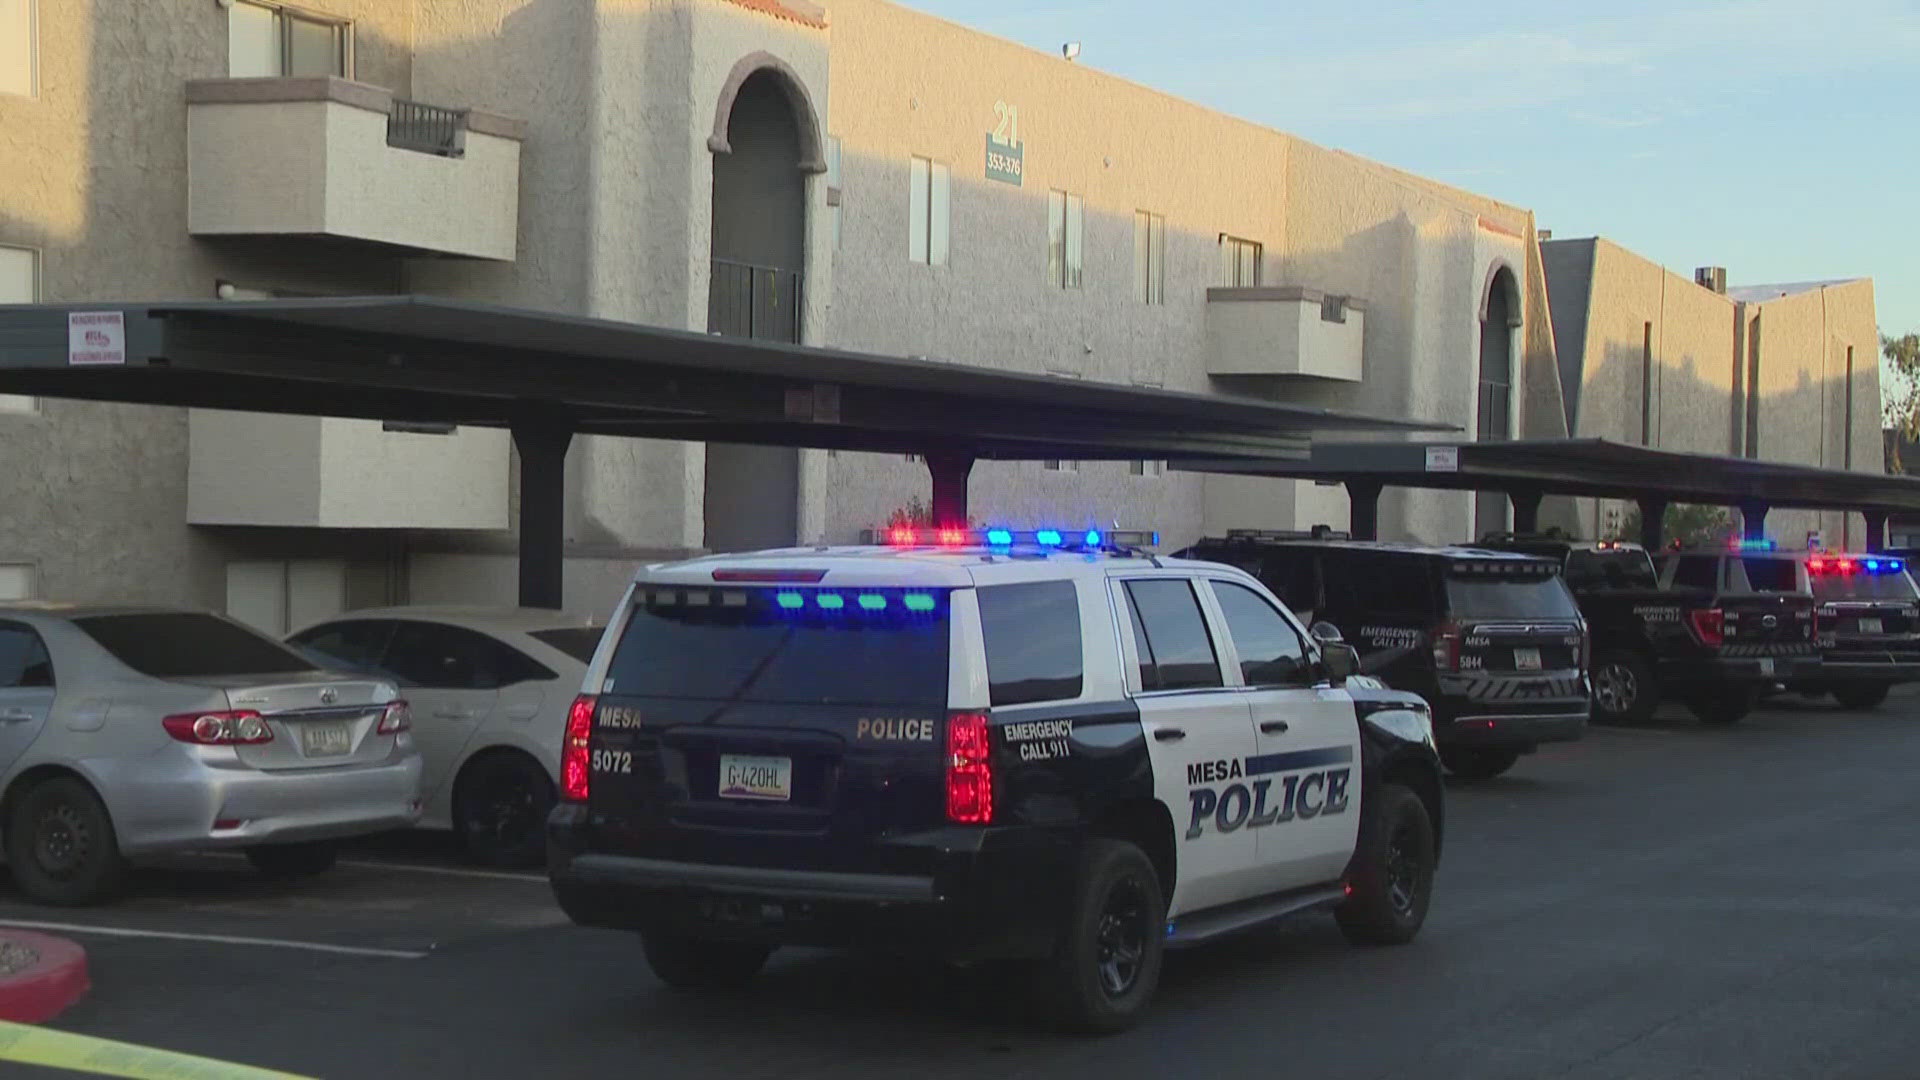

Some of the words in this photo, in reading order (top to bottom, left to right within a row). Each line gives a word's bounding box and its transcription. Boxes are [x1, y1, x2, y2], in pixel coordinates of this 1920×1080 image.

[992, 100, 1017, 149] 21
[987, 152, 1020, 176] 353-376
[1361, 626, 1417, 638] EMERGENCY
[1372, 637, 1395, 647] CALL
[1398, 639, 1416, 649] 911
[1465, 637, 1490, 646] MESA
[1460, 656, 1482, 669] 5844
[599, 706, 641, 729] MESA
[857, 718, 934, 741] POLICE
[1004, 720, 1073, 742] EMERGENCY
[592, 750, 632, 774] 5072
[1020, 742, 1049, 762] CALL
[1050, 740, 1070, 759] 911
[1187, 757, 1242, 786] MESA
[1185, 768, 1351, 842] POLICE
